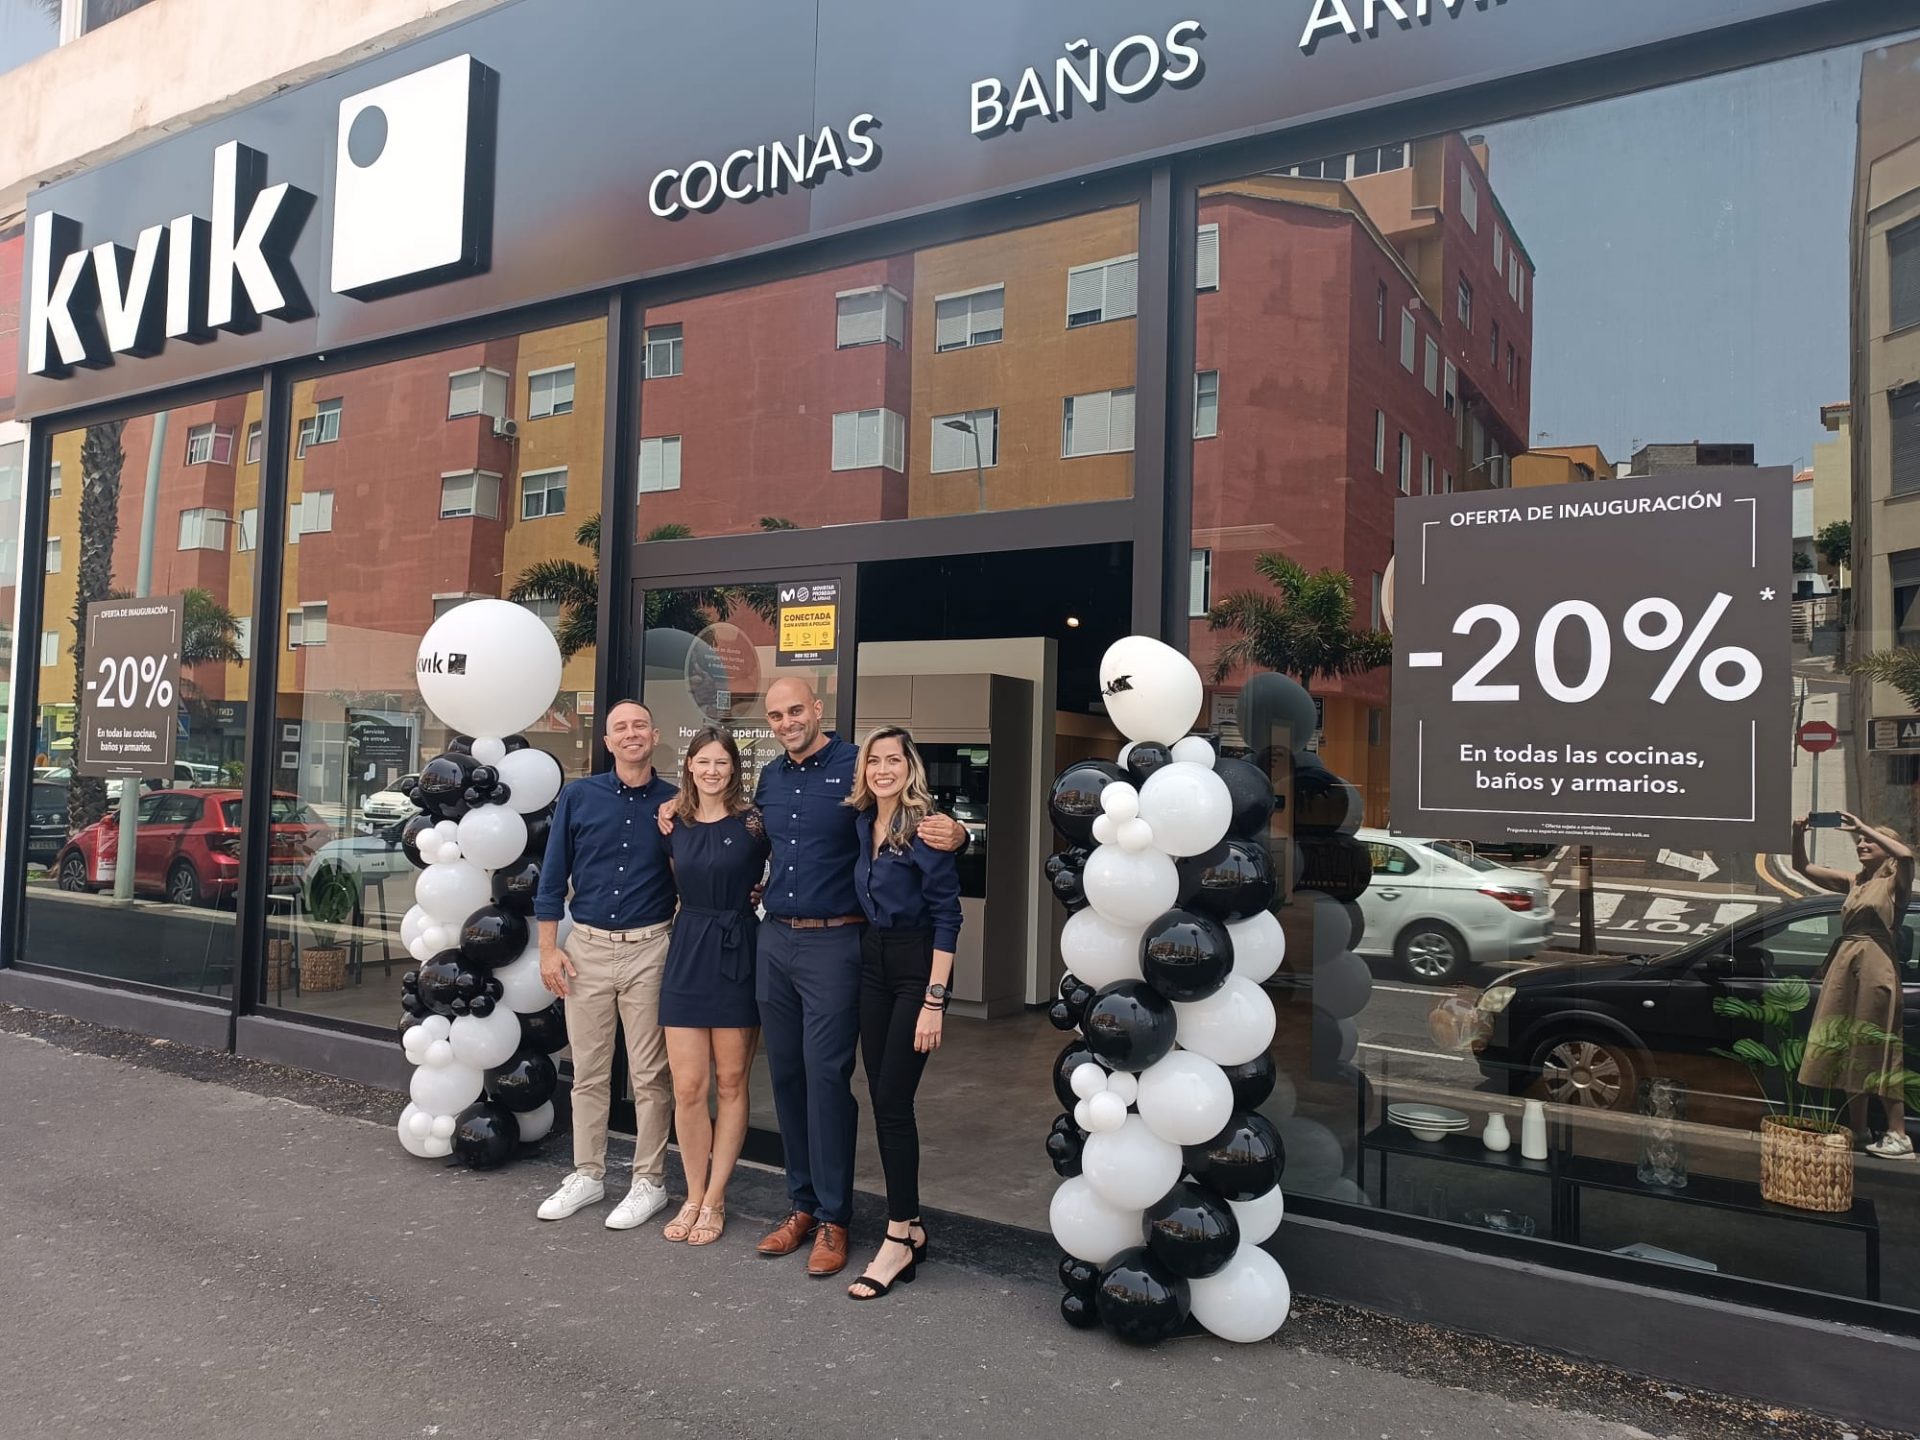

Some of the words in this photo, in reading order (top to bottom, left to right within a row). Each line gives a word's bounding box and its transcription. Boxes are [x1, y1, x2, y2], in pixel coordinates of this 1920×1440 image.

[649, 113, 876, 217] COCINAS
[970, 20, 1201, 134] BAÑOS
[28, 139, 289, 375] kvik
[1450, 508, 1522, 527] OFERTA
[1527, 506, 1554, 521] DE
[1559, 490, 1723, 519] INAUGURACIÓN
[101, 608, 120, 619] OFERTA
[120, 607, 128, 617] DE
[128, 604, 168, 617] INAUGURACIÓN
[784, 612, 831, 622] CONECTADA
[97, 728, 106, 738] En
[106, 728, 122, 738] todas
[124, 728, 132, 738] las
[133, 729, 157, 739] cocinas,
[732, 728, 775, 739] apertura
[100, 741, 118, 752] baños
[118, 744, 123, 754] y
[124, 743, 152, 752] armarios.
[756, 748, 776, 757] 20:00
[1460, 744, 1487, 762] En
[1494, 744, 1558, 763] todas
[1566, 744, 1598, 764] las
[1605, 746, 1705, 769] cocinas,
[1476, 771, 1544, 790] baños
[1551, 777, 1564, 795] y
[1571, 774, 1686, 794] armarios.
